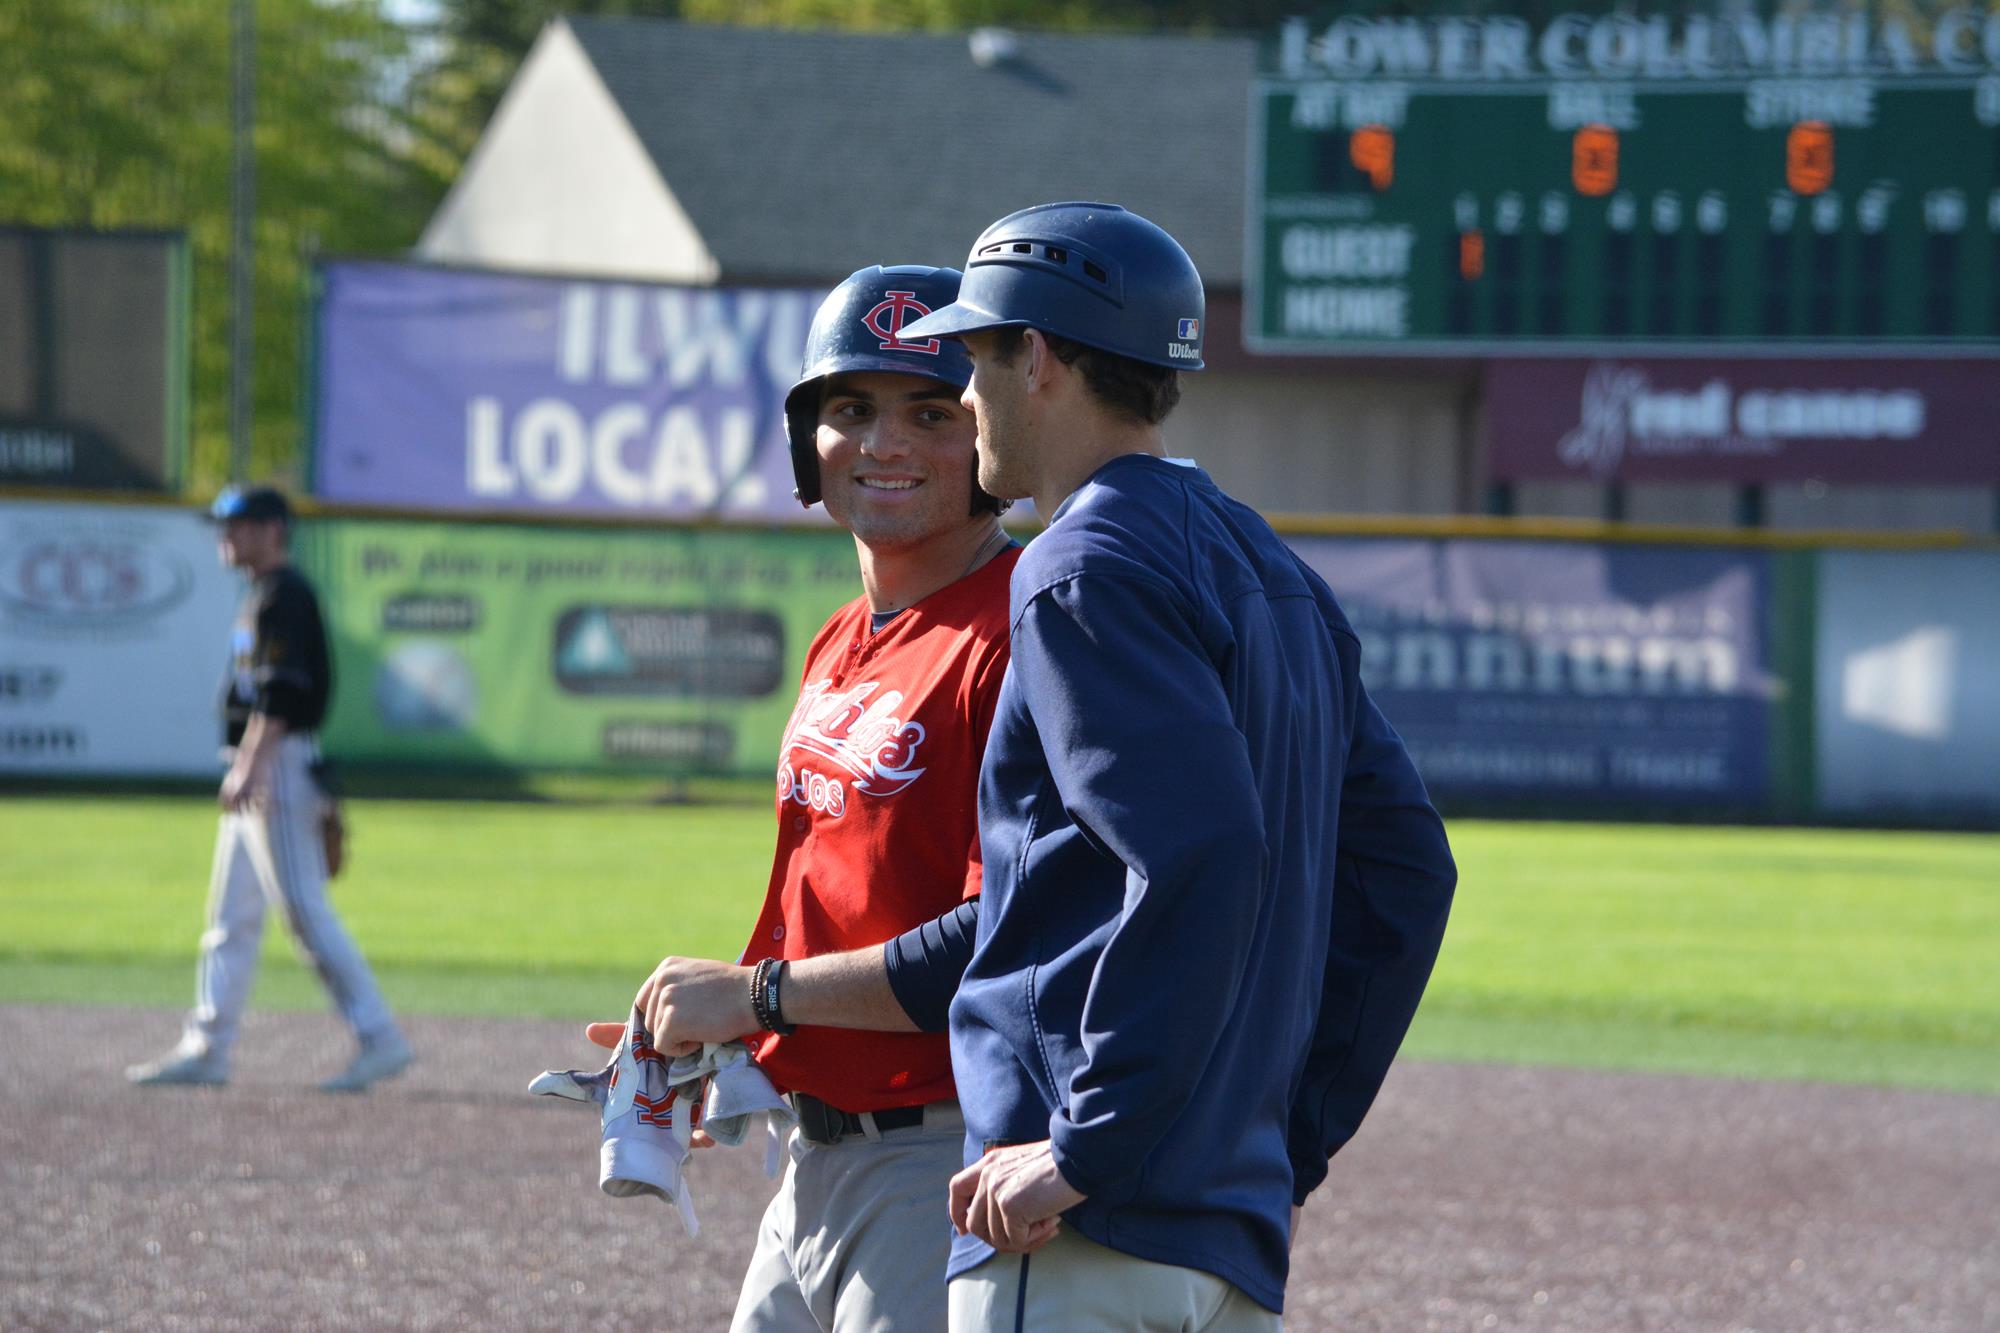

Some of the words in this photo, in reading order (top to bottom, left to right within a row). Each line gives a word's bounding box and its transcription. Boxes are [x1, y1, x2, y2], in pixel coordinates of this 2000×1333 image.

[1280, 14, 1530, 80] LOWER
[1540, 10, 1917, 80] COLUMBIA
[1280, 224, 1413, 279] GUEST
[1282, 287, 1410, 337] HOME
[1168, 342, 1200, 359] Wilson
[467, 400, 765, 503] LOCAL
